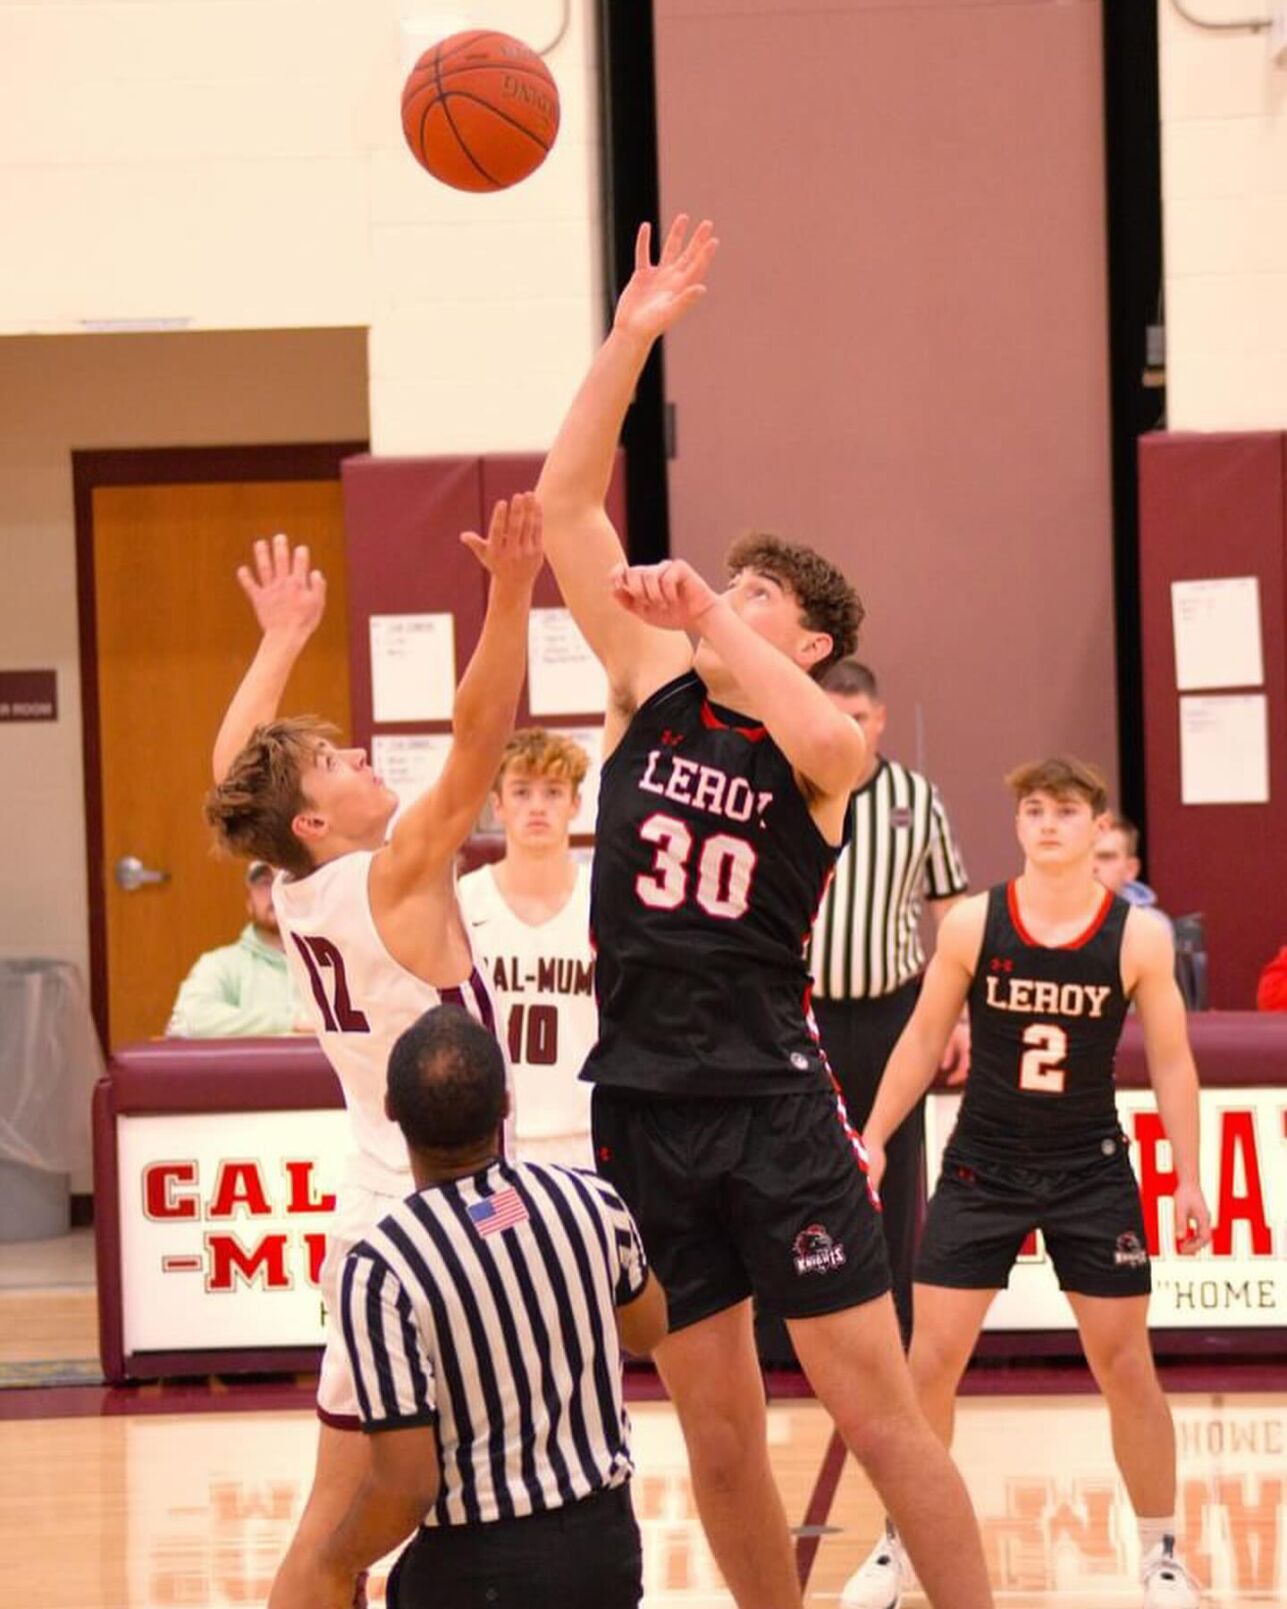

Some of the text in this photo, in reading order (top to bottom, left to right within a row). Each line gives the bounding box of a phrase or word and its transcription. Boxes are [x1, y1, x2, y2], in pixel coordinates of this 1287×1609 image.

[634, 812, 757, 921] 30
[290, 930, 371, 1034] 12
[484, 956, 594, 997] AL-MUM
[986, 975, 1112, 1019] LEROY
[507, 1003, 558, 1065] 10
[1019, 1022, 1069, 1094] 2
[142, 1159, 337, 1221] CAL
